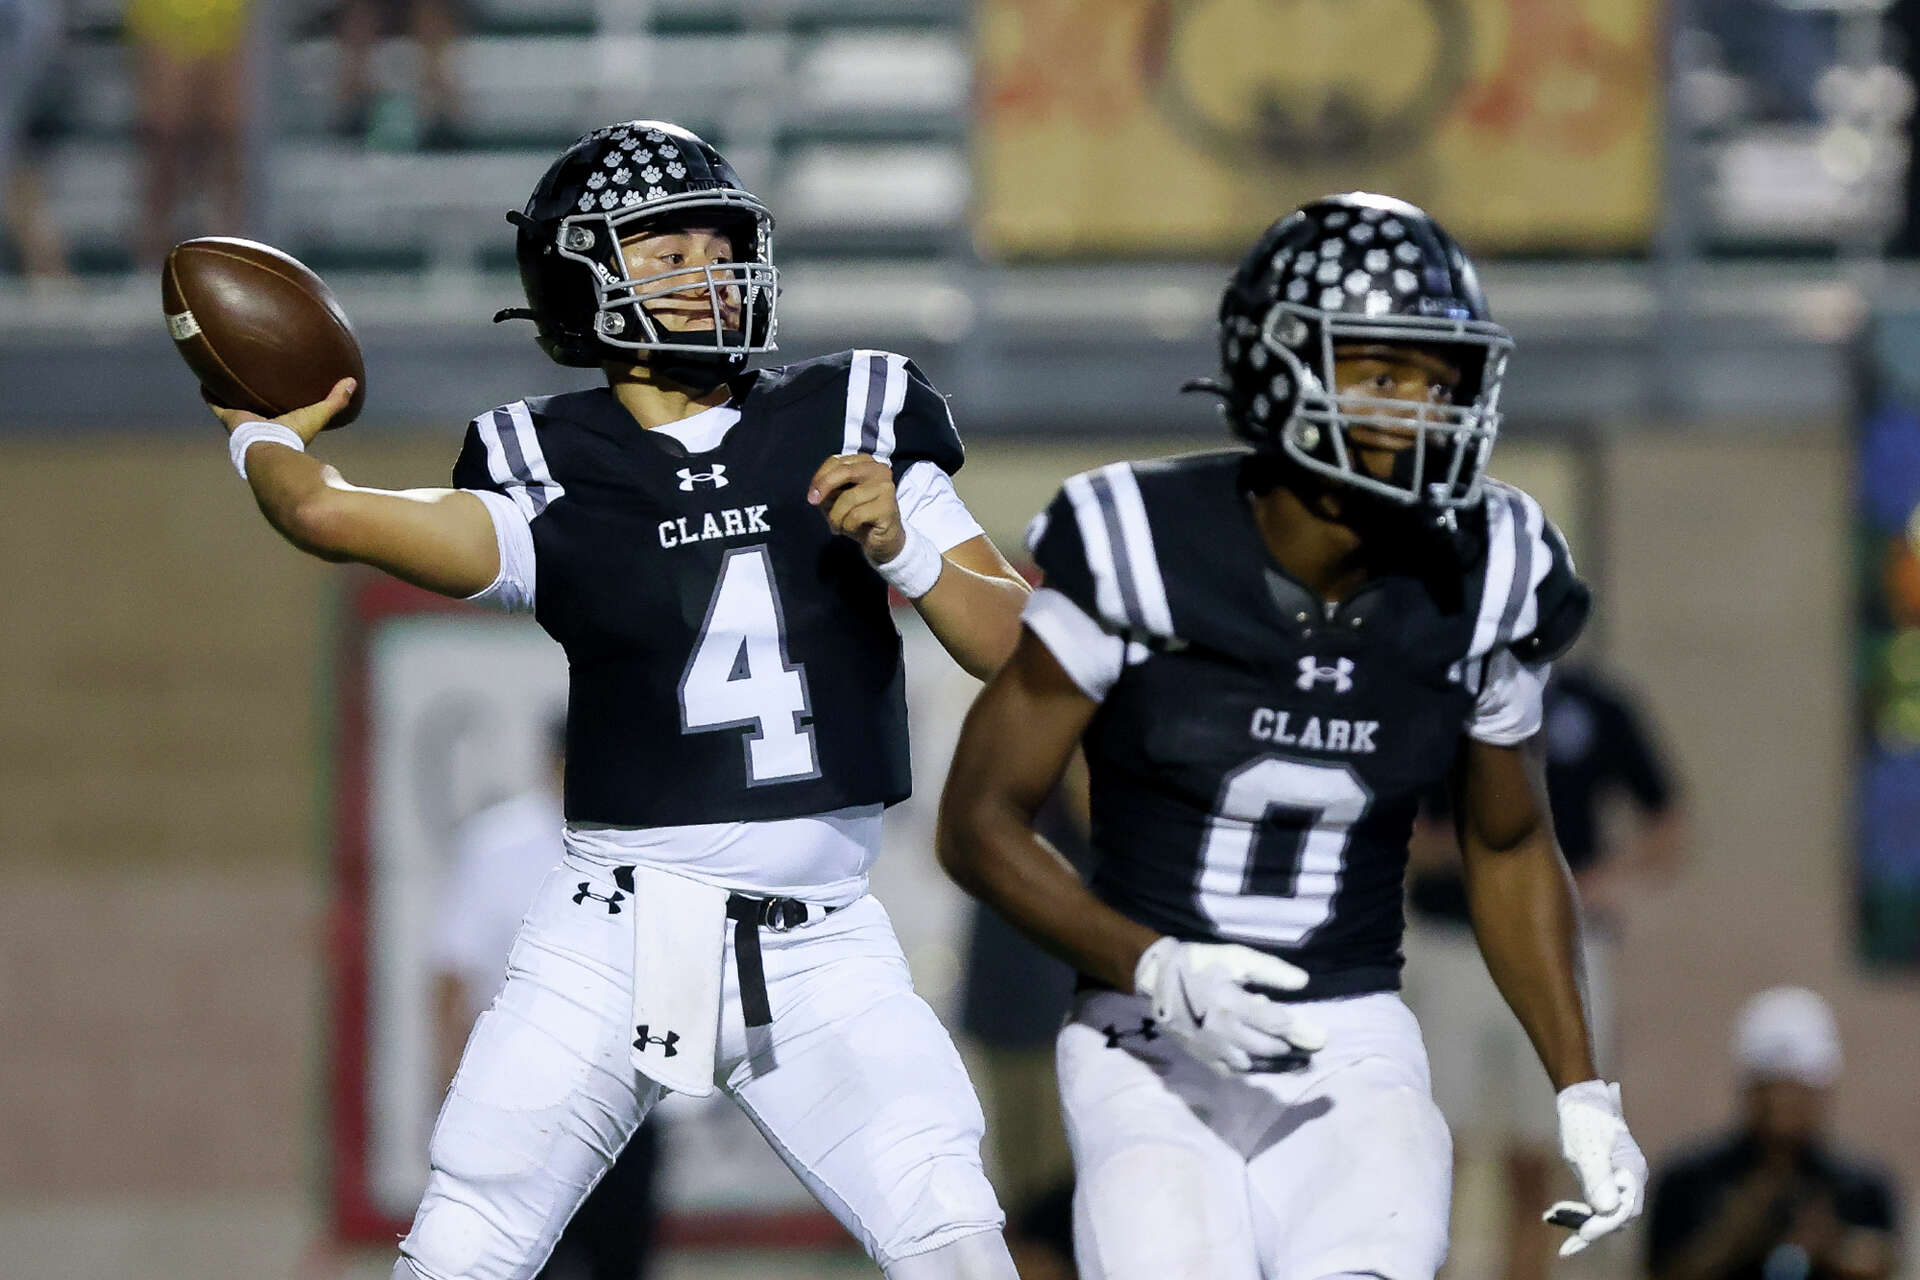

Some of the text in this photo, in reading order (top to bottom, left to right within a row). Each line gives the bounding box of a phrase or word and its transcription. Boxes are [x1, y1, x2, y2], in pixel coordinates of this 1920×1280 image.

[658, 504, 771, 549] CLARK
[677, 543, 822, 788] 4
[1250, 707, 1380, 753] CLARK
[1194, 753, 1375, 948] 0
